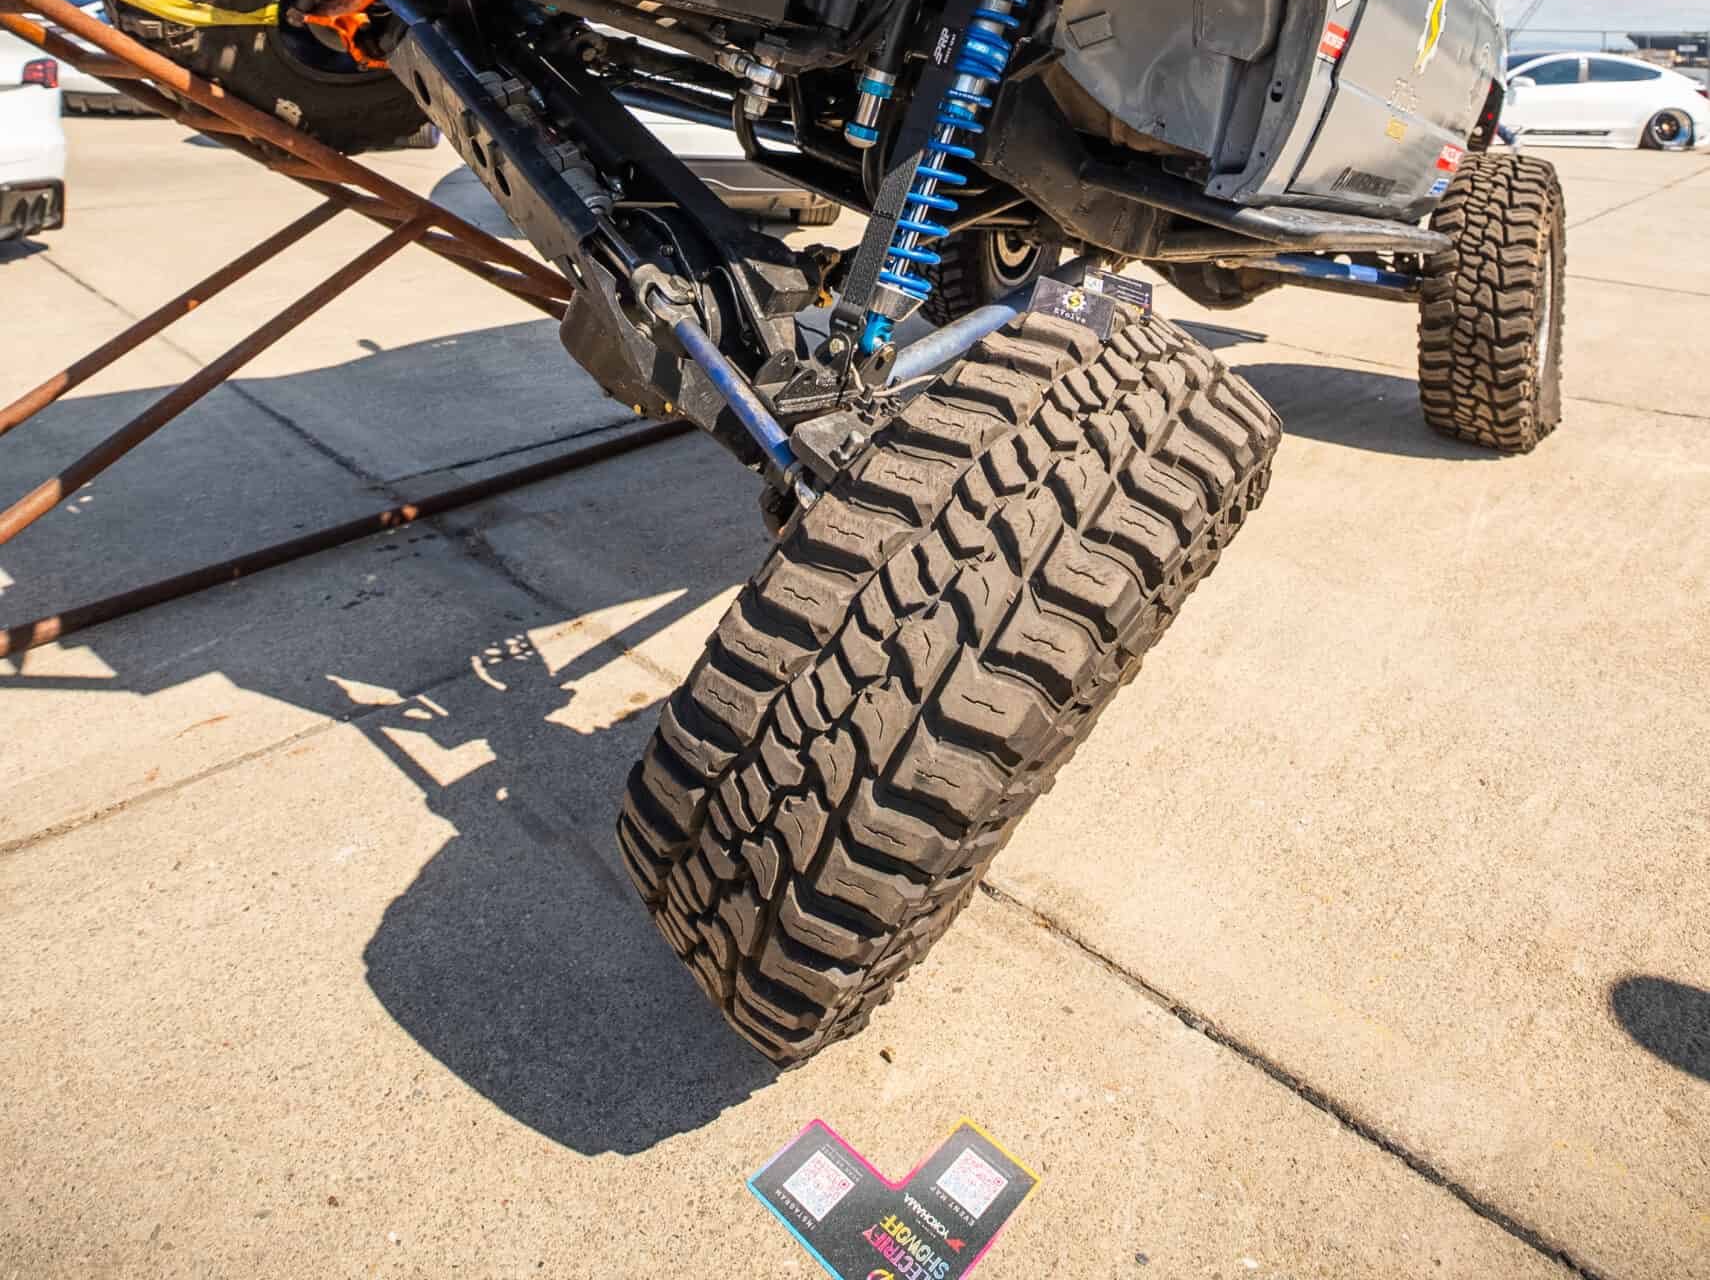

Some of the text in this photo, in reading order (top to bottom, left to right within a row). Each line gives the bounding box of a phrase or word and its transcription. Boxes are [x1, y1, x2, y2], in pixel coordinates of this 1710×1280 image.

[904, 1192, 950, 1240] YOKOHAMA
[862, 1223, 935, 1280] LECTRIFY
[880, 1214, 950, 1280] SHOWOFF
